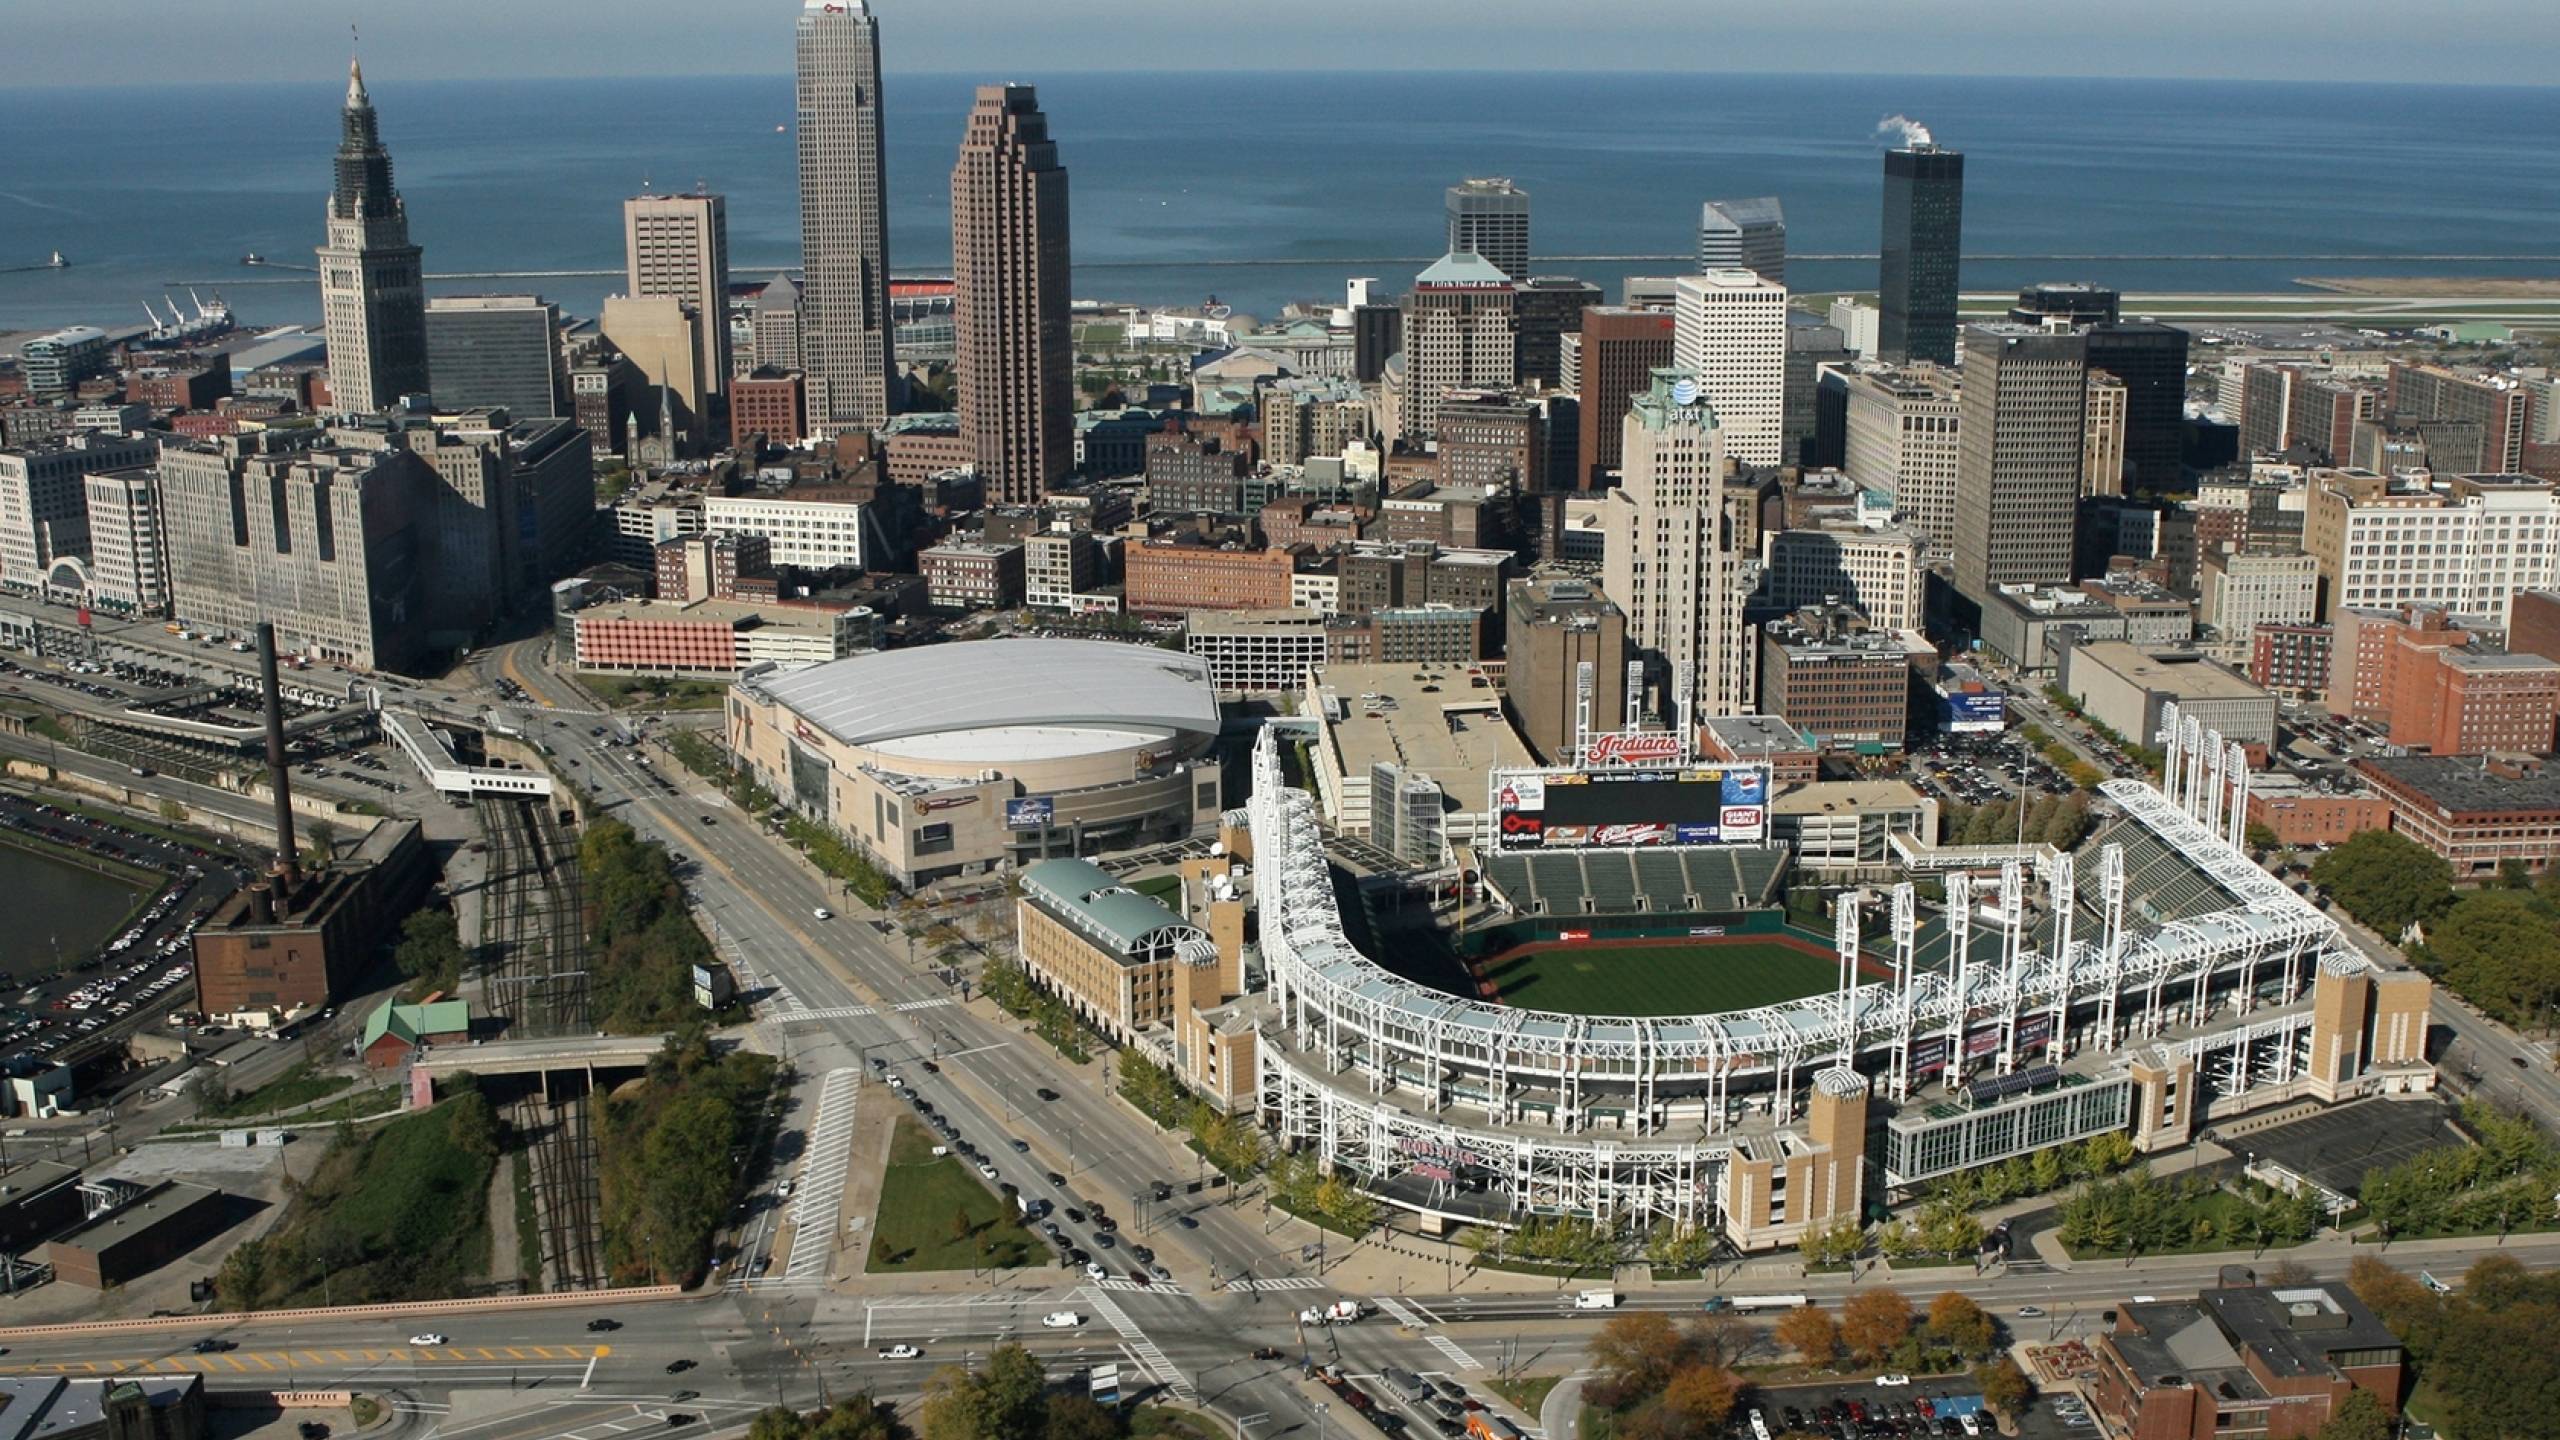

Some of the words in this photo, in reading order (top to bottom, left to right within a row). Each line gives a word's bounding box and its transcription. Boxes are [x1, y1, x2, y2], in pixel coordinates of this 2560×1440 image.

[1431, 280, 1454, 288] Fifth
[1455, 280, 1477, 288] Third
[1480, 280, 1501, 288] Bank
[1670, 407, 1700, 421] at&t
[1588, 734, 1680, 763] Indians
[1725, 810, 1757, 818] GIANT
[1726, 816, 1756, 825] EAGLE
[1502, 832, 1541, 843] KeyBank
